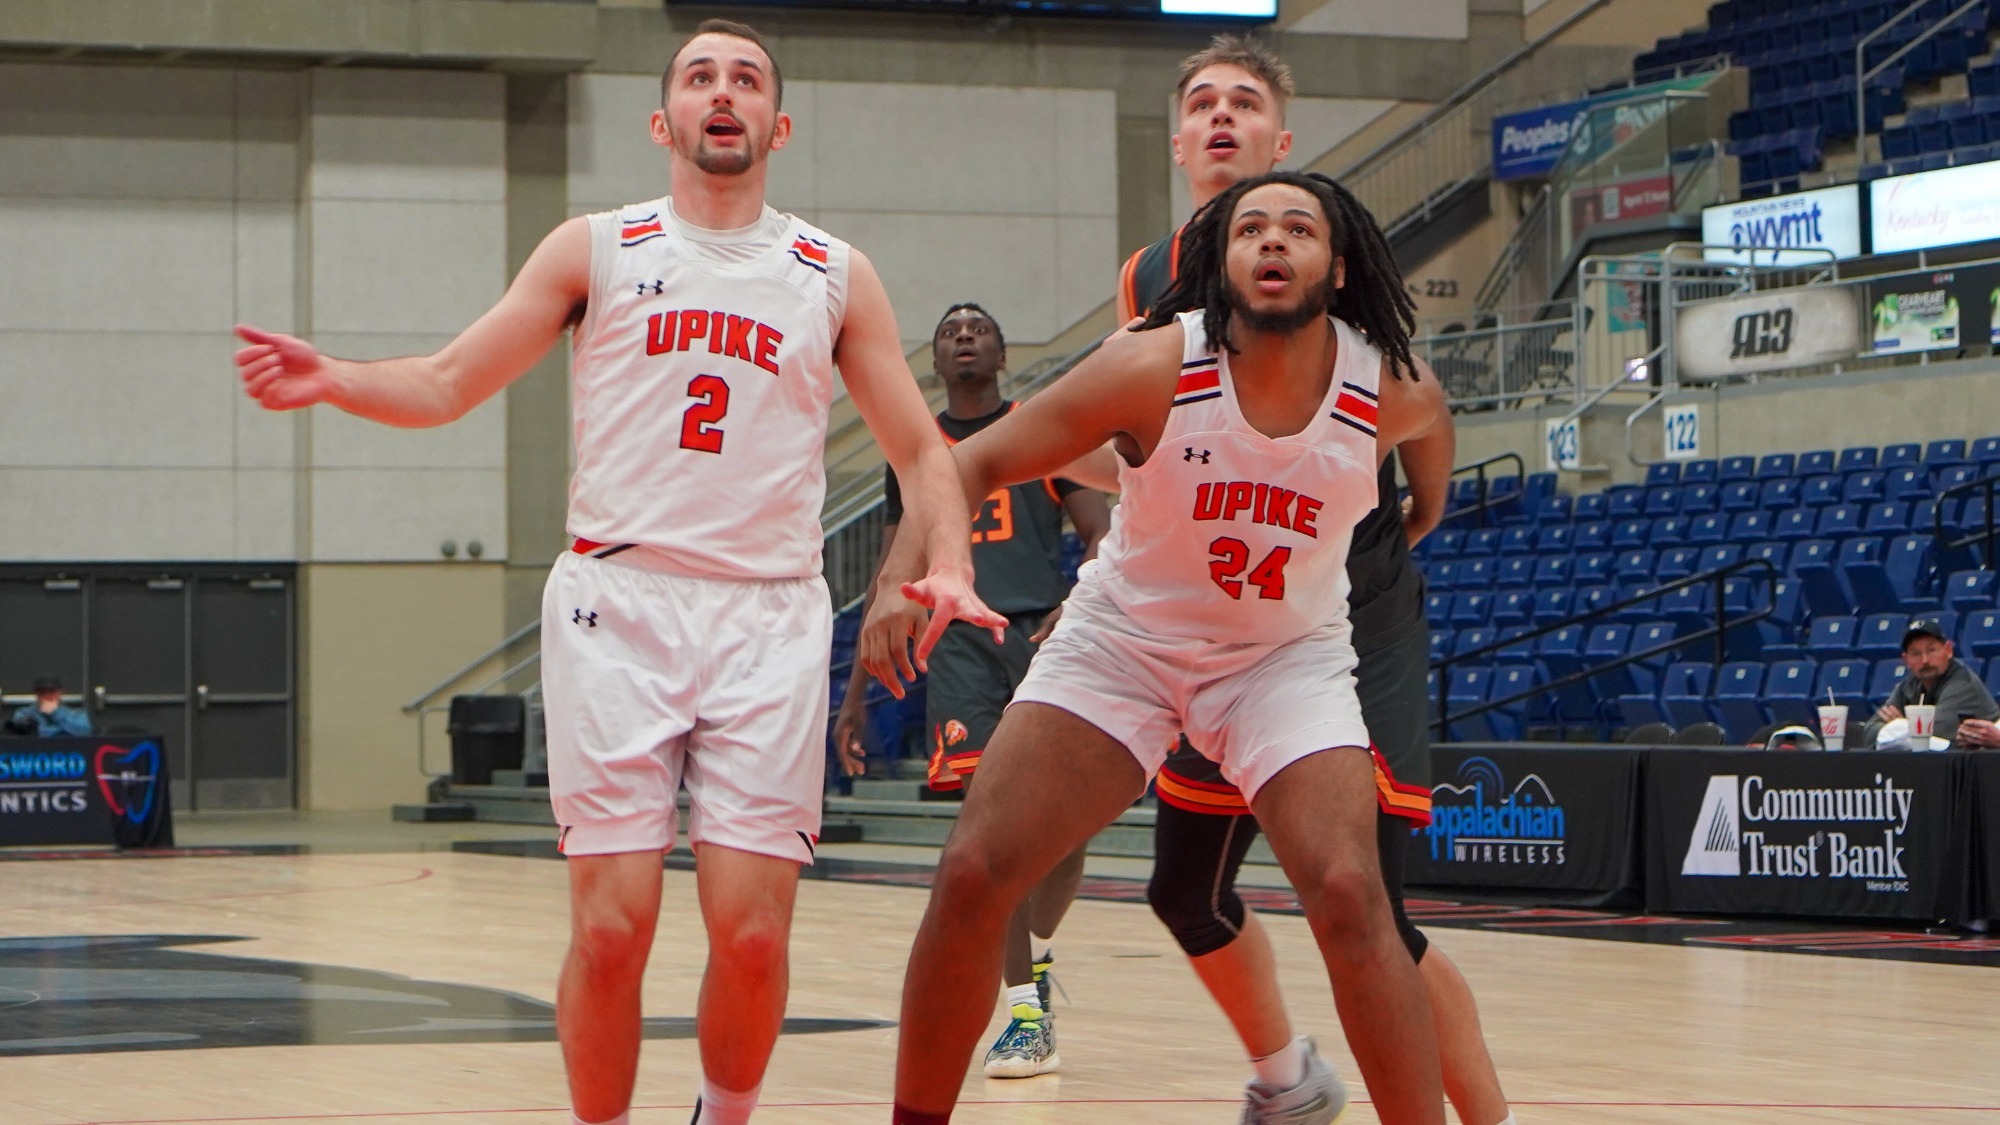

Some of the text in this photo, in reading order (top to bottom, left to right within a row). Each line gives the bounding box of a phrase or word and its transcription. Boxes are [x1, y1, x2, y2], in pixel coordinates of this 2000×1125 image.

[1501, 119, 1570, 154] Peoples
[1747, 201, 1823, 264] wymt
[1425, 280, 1458, 298] 223
[646, 309, 784, 377] UPIKE
[678, 373, 731, 455] 2
[1666, 412, 1698, 452] 122
[970, 487, 1014, 543] 3
[1192, 481, 1324, 539] UPIKE
[1208, 536, 1292, 600] 24
[0, 790, 88, 814] NTICS
[1411, 780, 1565, 862] ppalachian
[1741, 772, 1915, 836] Community
[1454, 844, 1566, 864] WIRELESS
[1742, 829, 1908, 879] Trust Bank
